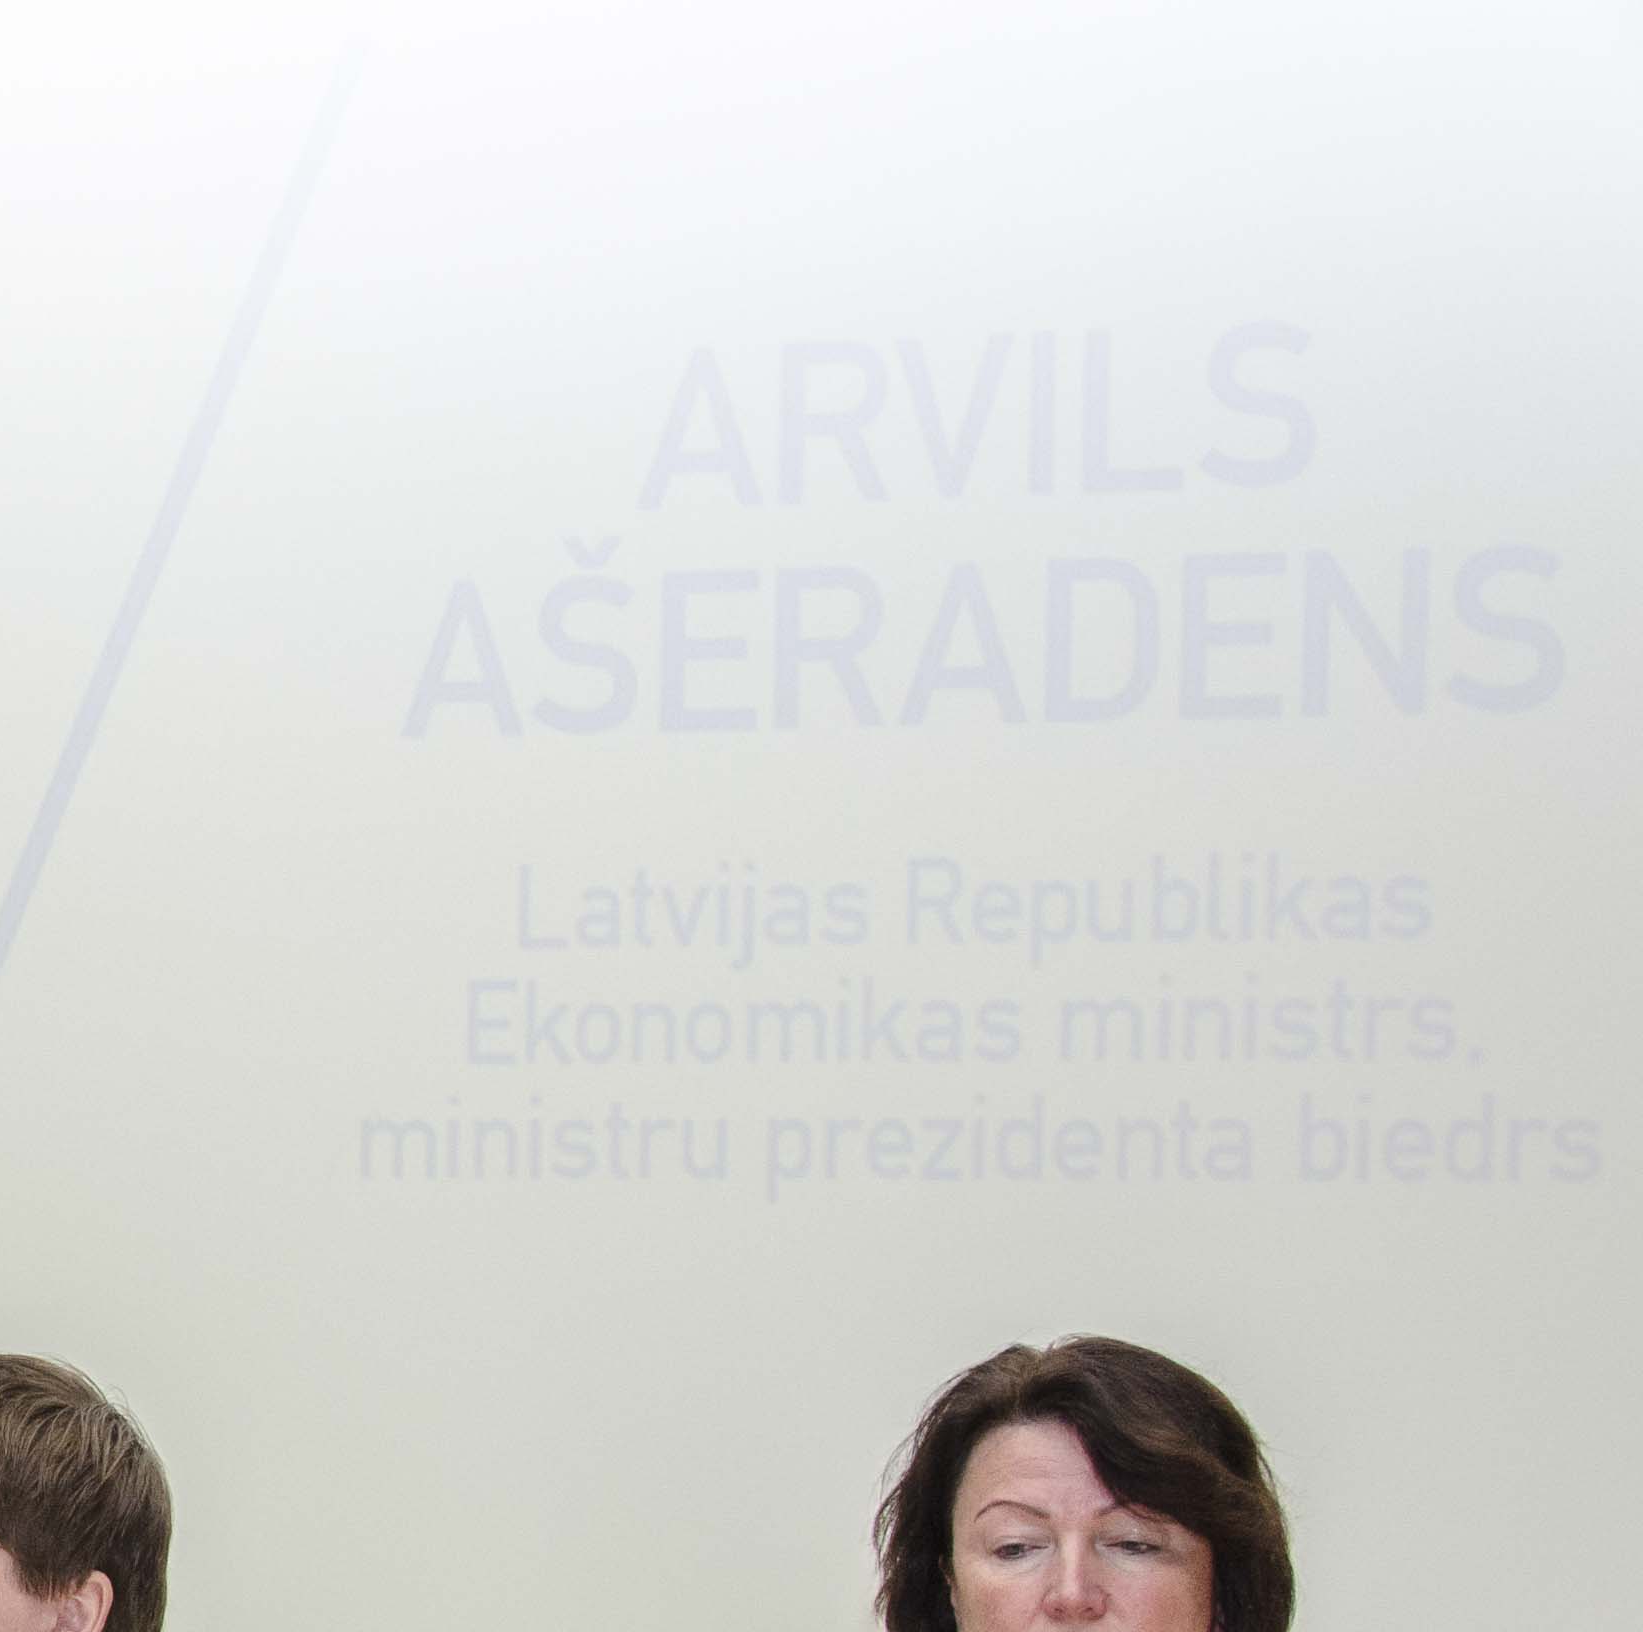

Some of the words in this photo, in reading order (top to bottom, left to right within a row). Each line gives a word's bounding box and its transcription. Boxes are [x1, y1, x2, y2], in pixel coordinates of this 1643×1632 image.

[637, 320, 1319, 510] ARVILS
[399, 534, 1567, 739] AŠERADENS
[516, 863, 870, 970] Latvijas
[904, 852, 1433, 966] Republikas
[464, 972, 1022, 1068] Ekonomikas
[358, 1098, 732, 1184] ministru
[765, 1094, 1255, 1204] prezidenta
[1297, 1092, 1602, 1184] biedrs
